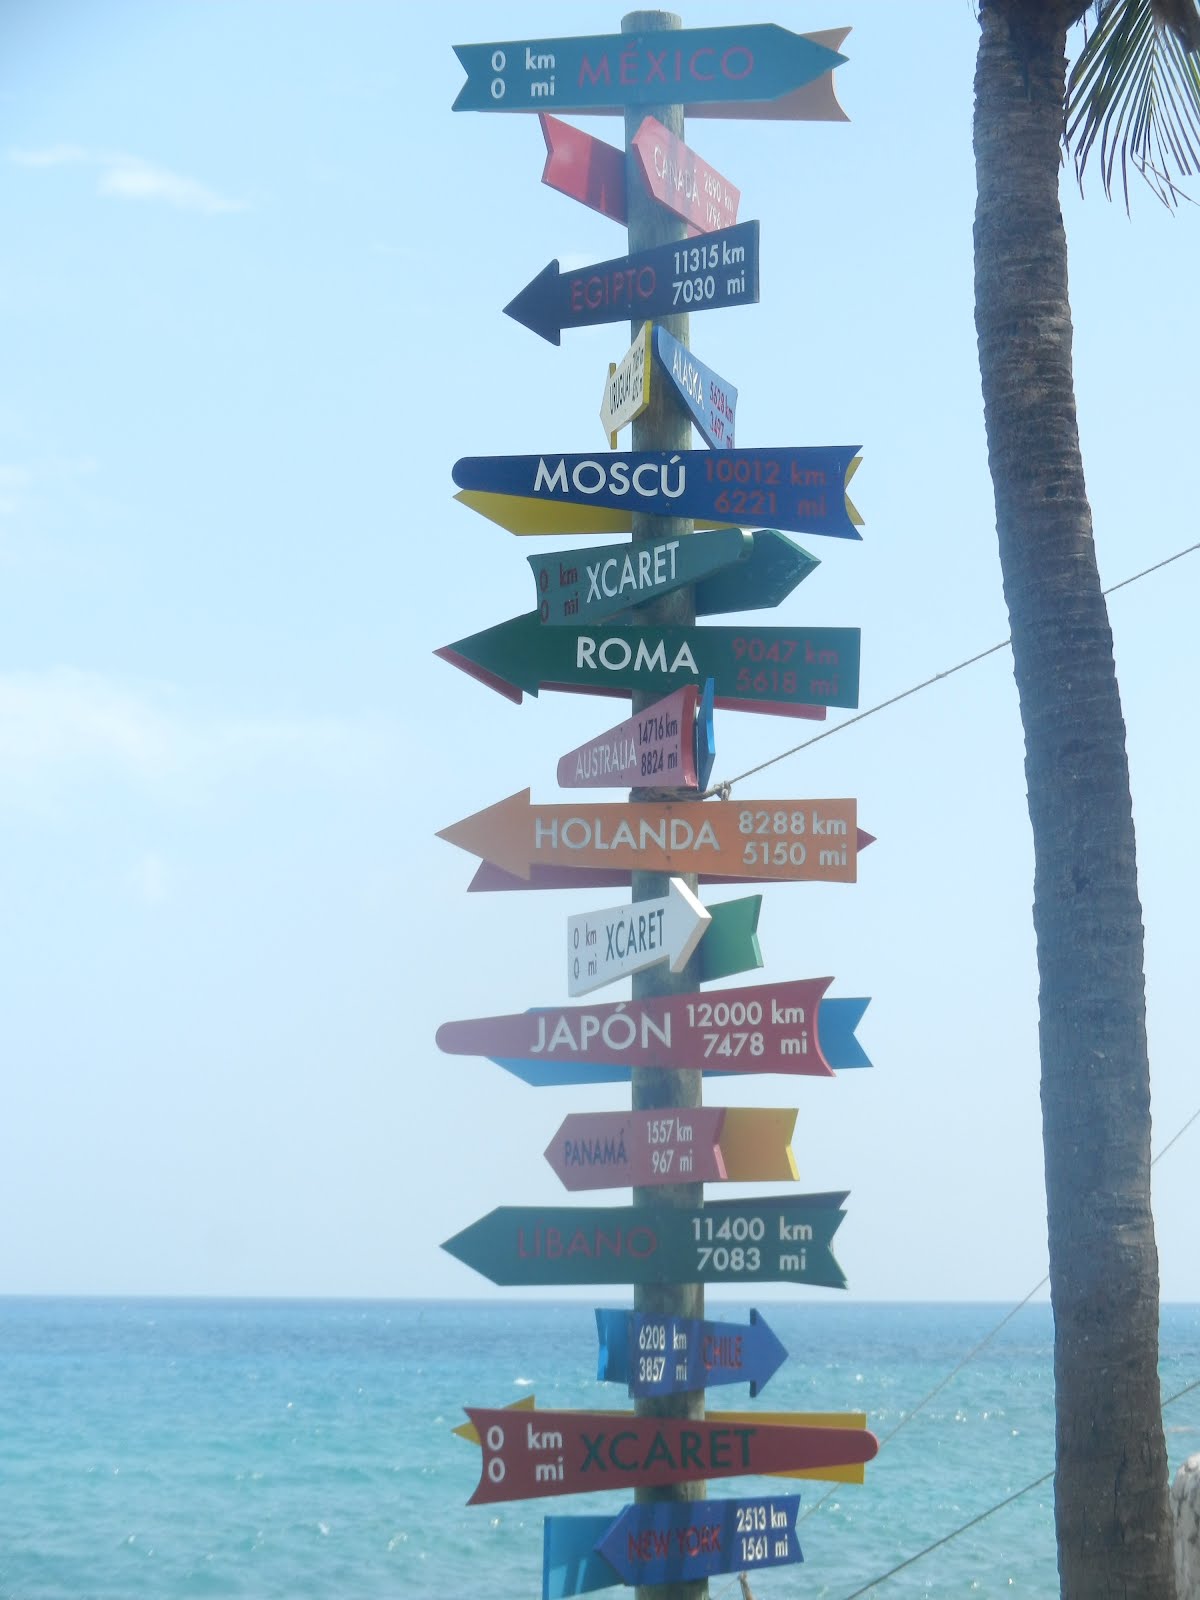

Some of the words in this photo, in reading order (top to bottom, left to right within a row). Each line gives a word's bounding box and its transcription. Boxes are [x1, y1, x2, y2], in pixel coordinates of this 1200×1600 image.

[491, 51, 506, 71] 0
[525, 48, 555, 71] km
[577, 41, 755, 88] MÉXICO
[490, 78, 506, 98] 0
[530, 76, 555, 97] mi
[725, 187, 734, 213] km
[673, 244, 719, 275] 11315
[722, 242, 745, 265] km
[570, 266, 656, 312] EGIPTO
[672, 276, 715, 305] 7030
[727, 275, 745, 295] mi
[673, 347, 704, 410] ALASKA
[725, 395, 734, 424] km
[533, 455, 687, 498] MOSCÚ
[705, 457, 781, 486] 10012
[790, 463, 827, 488] km
[715, 490, 777, 516] 6221
[798, 493, 827, 517] mi
[540, 569, 548, 593] 0
[559, 562, 578, 587] km
[586, 541, 680, 604] XCARET
[541, 600, 549, 623] 0
[564, 592, 579, 616] mi
[575, 636, 700, 675] ROMA
[732, 638, 797, 663] 9047
[805, 641, 838, 667] km
[736, 671, 797, 694] 5618
[810, 674, 838, 697] mi
[638, 716, 664, 745] 14716
[665, 712, 678, 737] km
[575, 737, 637, 781] AUSTRALIA
[641, 750, 664, 776] 8824
[667, 746, 678, 769] mi
[534, 817, 720, 852] HOLANDA
[738, 811, 806, 836] 8288
[812, 810, 847, 836] km
[743, 841, 806, 866] 5150
[819, 843, 847, 866] mi
[573, 927, 580, 948] 0
[585, 922, 597, 945] km
[605, 908, 665, 962] XCARET
[573, 956, 580, 977] 0
[588, 953, 597, 976] mi
[685, 1002, 762, 1028] 12000
[770, 999, 805, 1024] km
[530, 1003, 672, 1054] JAPÓN
[703, 1032, 765, 1058] 7478
[780, 1030, 807, 1055] mi
[647, 1119, 674, 1144] 1557
[676, 1117, 693, 1142] km
[564, 1128, 627, 1167] PANAMÁ
[652, 1149, 674, 1174] 967
[679, 1149, 693, 1172] mi
[518, 1219, 657, 1258] LÍBANO
[691, 1217, 765, 1242] 11400
[779, 1216, 813, 1242] km
[696, 1246, 761, 1272] 7083
[779, 1246, 807, 1271] mi
[638, 1325, 666, 1351] 6208
[673, 1325, 687, 1351] km
[703, 1336, 743, 1370] CHILE
[638, 1356, 666, 1384] 3857
[675, 1357, 688, 1382] mi
[486, 1424, 504, 1451] 0
[527, 1423, 563, 1449] km
[579, 1428, 758, 1472] XCARET
[487, 1458, 506, 1484] 0
[535, 1457, 565, 1482] mi
[736, 1506, 766, 1532] 2513
[770, 1504, 787, 1528] km
[627, 1530, 671, 1562] NEW
[677, 1525, 721, 1558] YORK
[741, 1535, 768, 1561] 1561
[775, 1534, 788, 1557] mi
